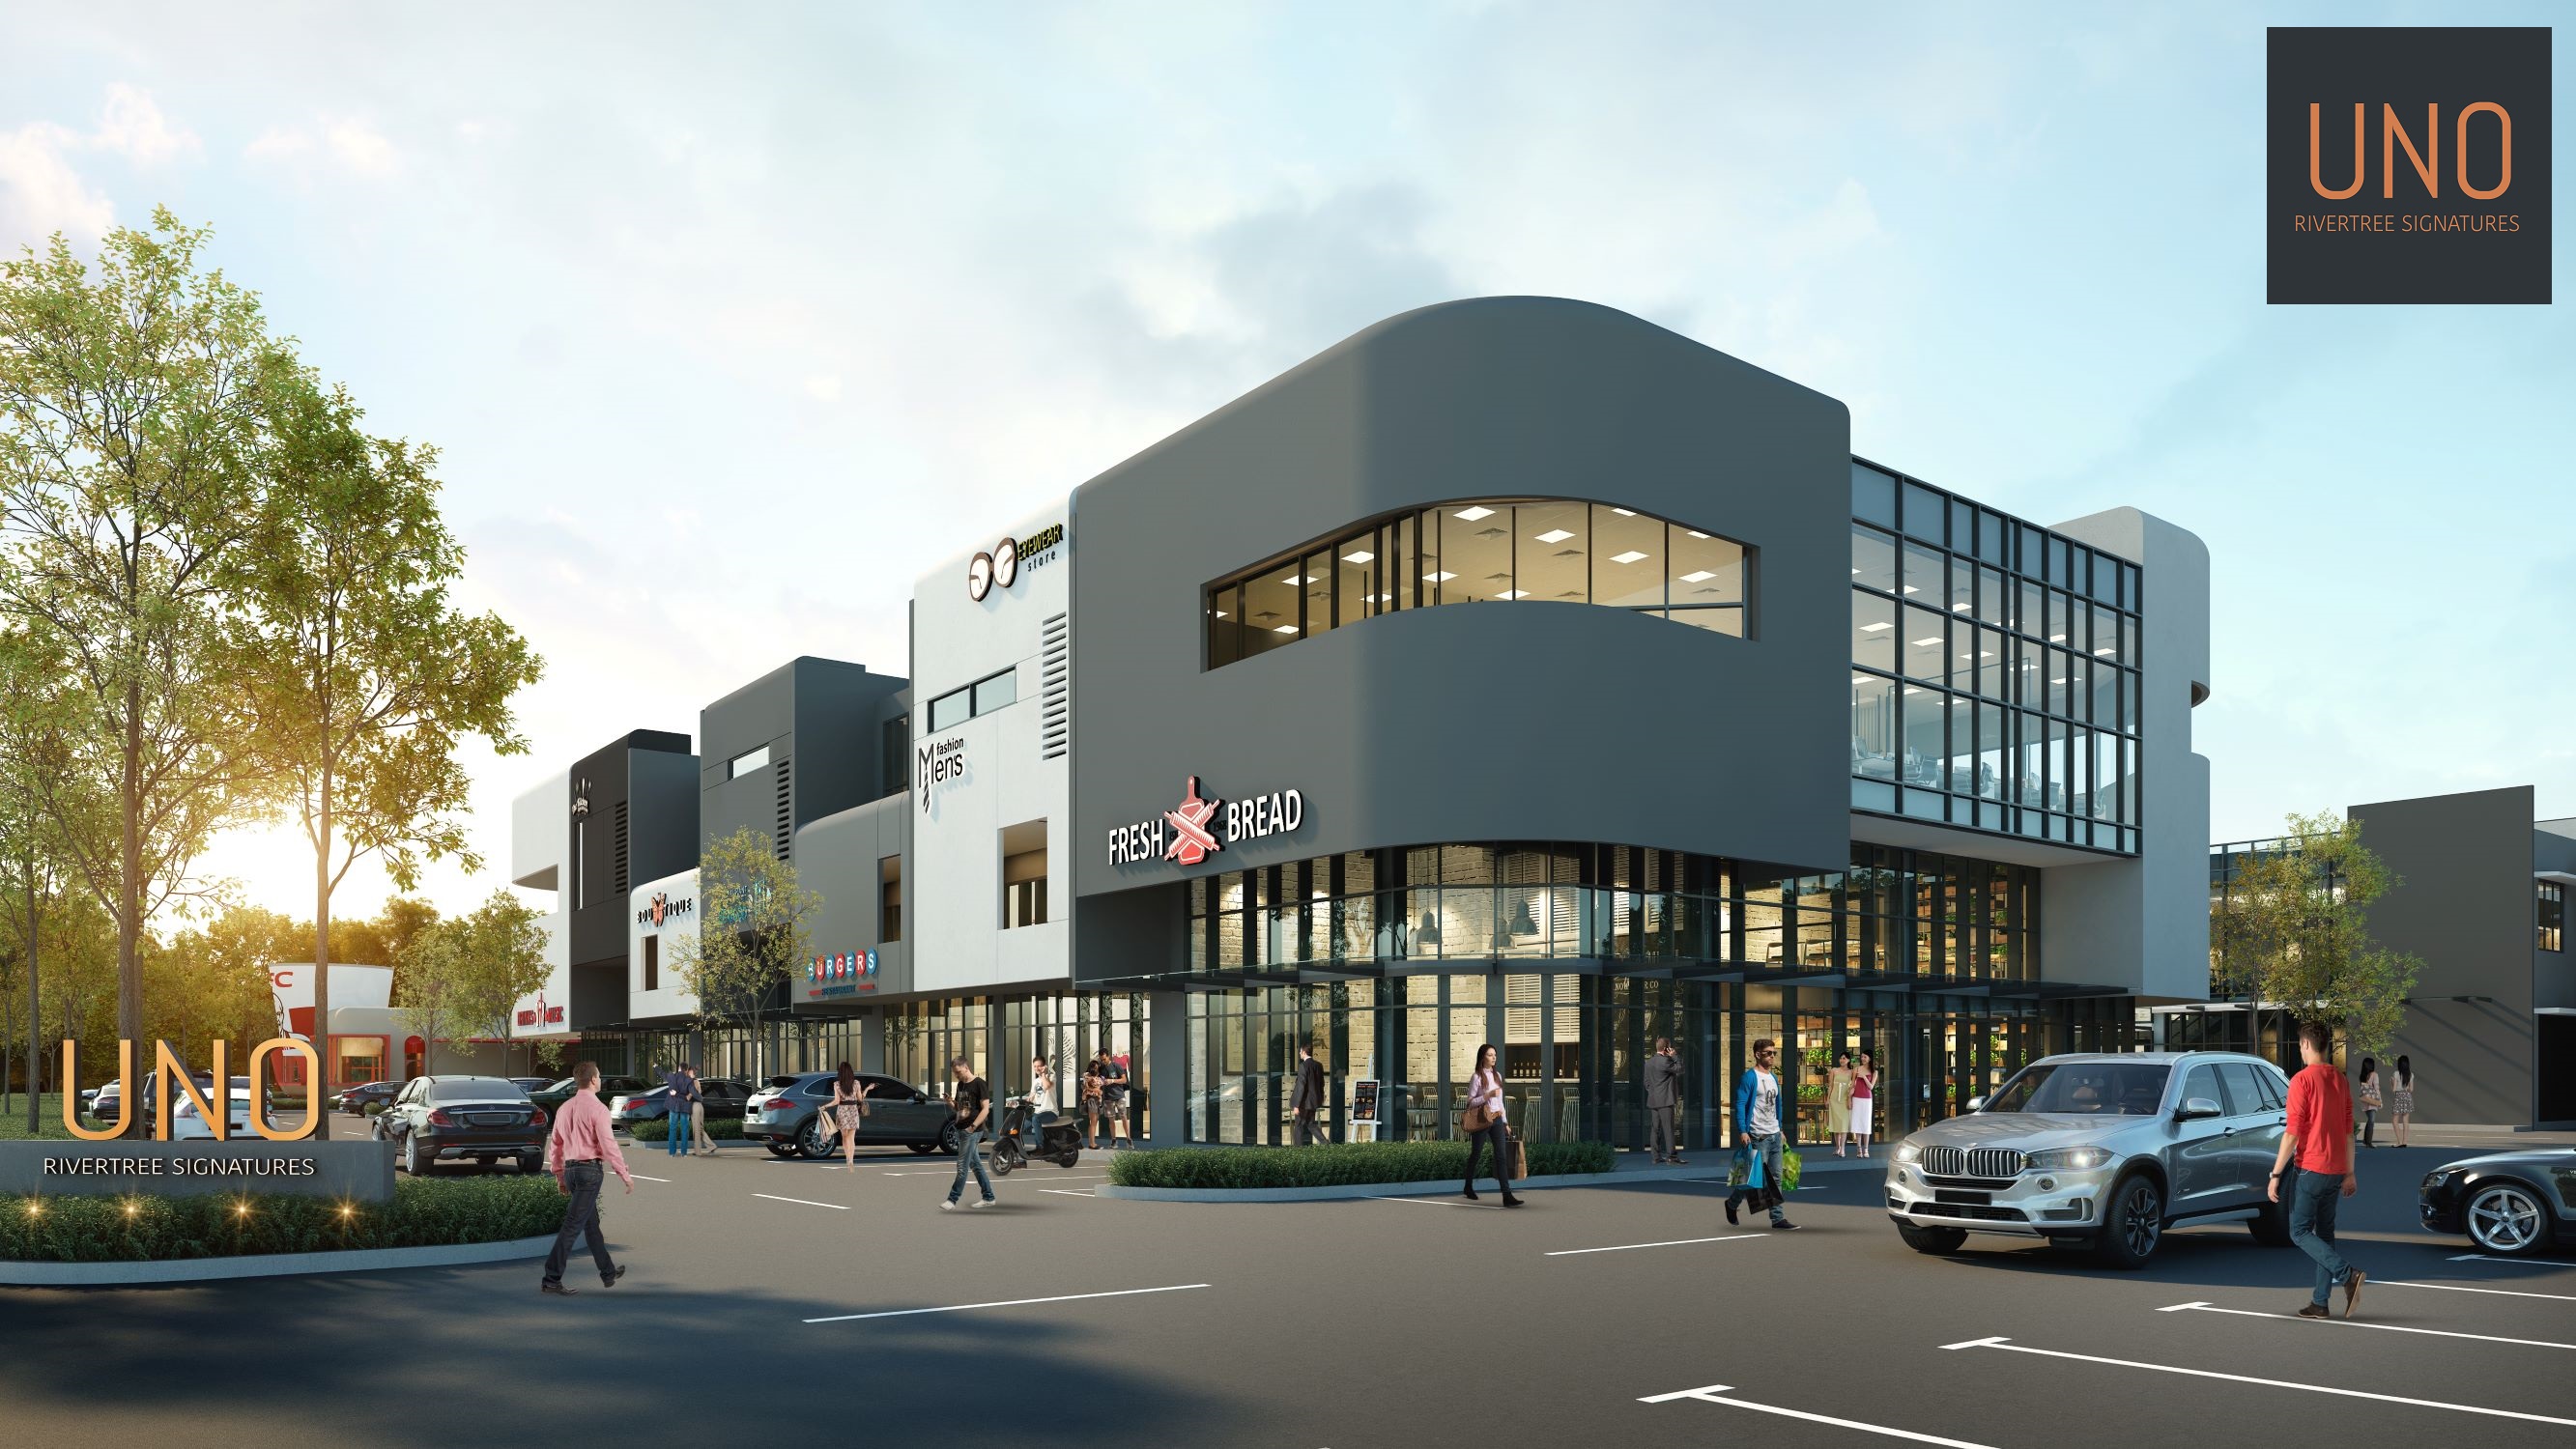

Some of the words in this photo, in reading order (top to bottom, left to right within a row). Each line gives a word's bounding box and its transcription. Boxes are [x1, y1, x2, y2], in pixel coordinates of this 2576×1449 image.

[1017, 523, 1063, 561] EYEWEAR
[1027, 551, 1056, 572] store
[936, 737, 964, 755] fashion
[918, 743, 963, 789] Men's
[1109, 818, 1164, 866] FRESH
[1227, 788, 1302, 843] BREAD
[637, 897, 692, 923] BOUTIQUE
[808, 952, 875, 978] BURGERS
[63, 1038, 320, 1142] UNO
[44, 1158, 163, 1175] RIVERTREE
[172, 1158, 315, 1176] SIGNATURES
